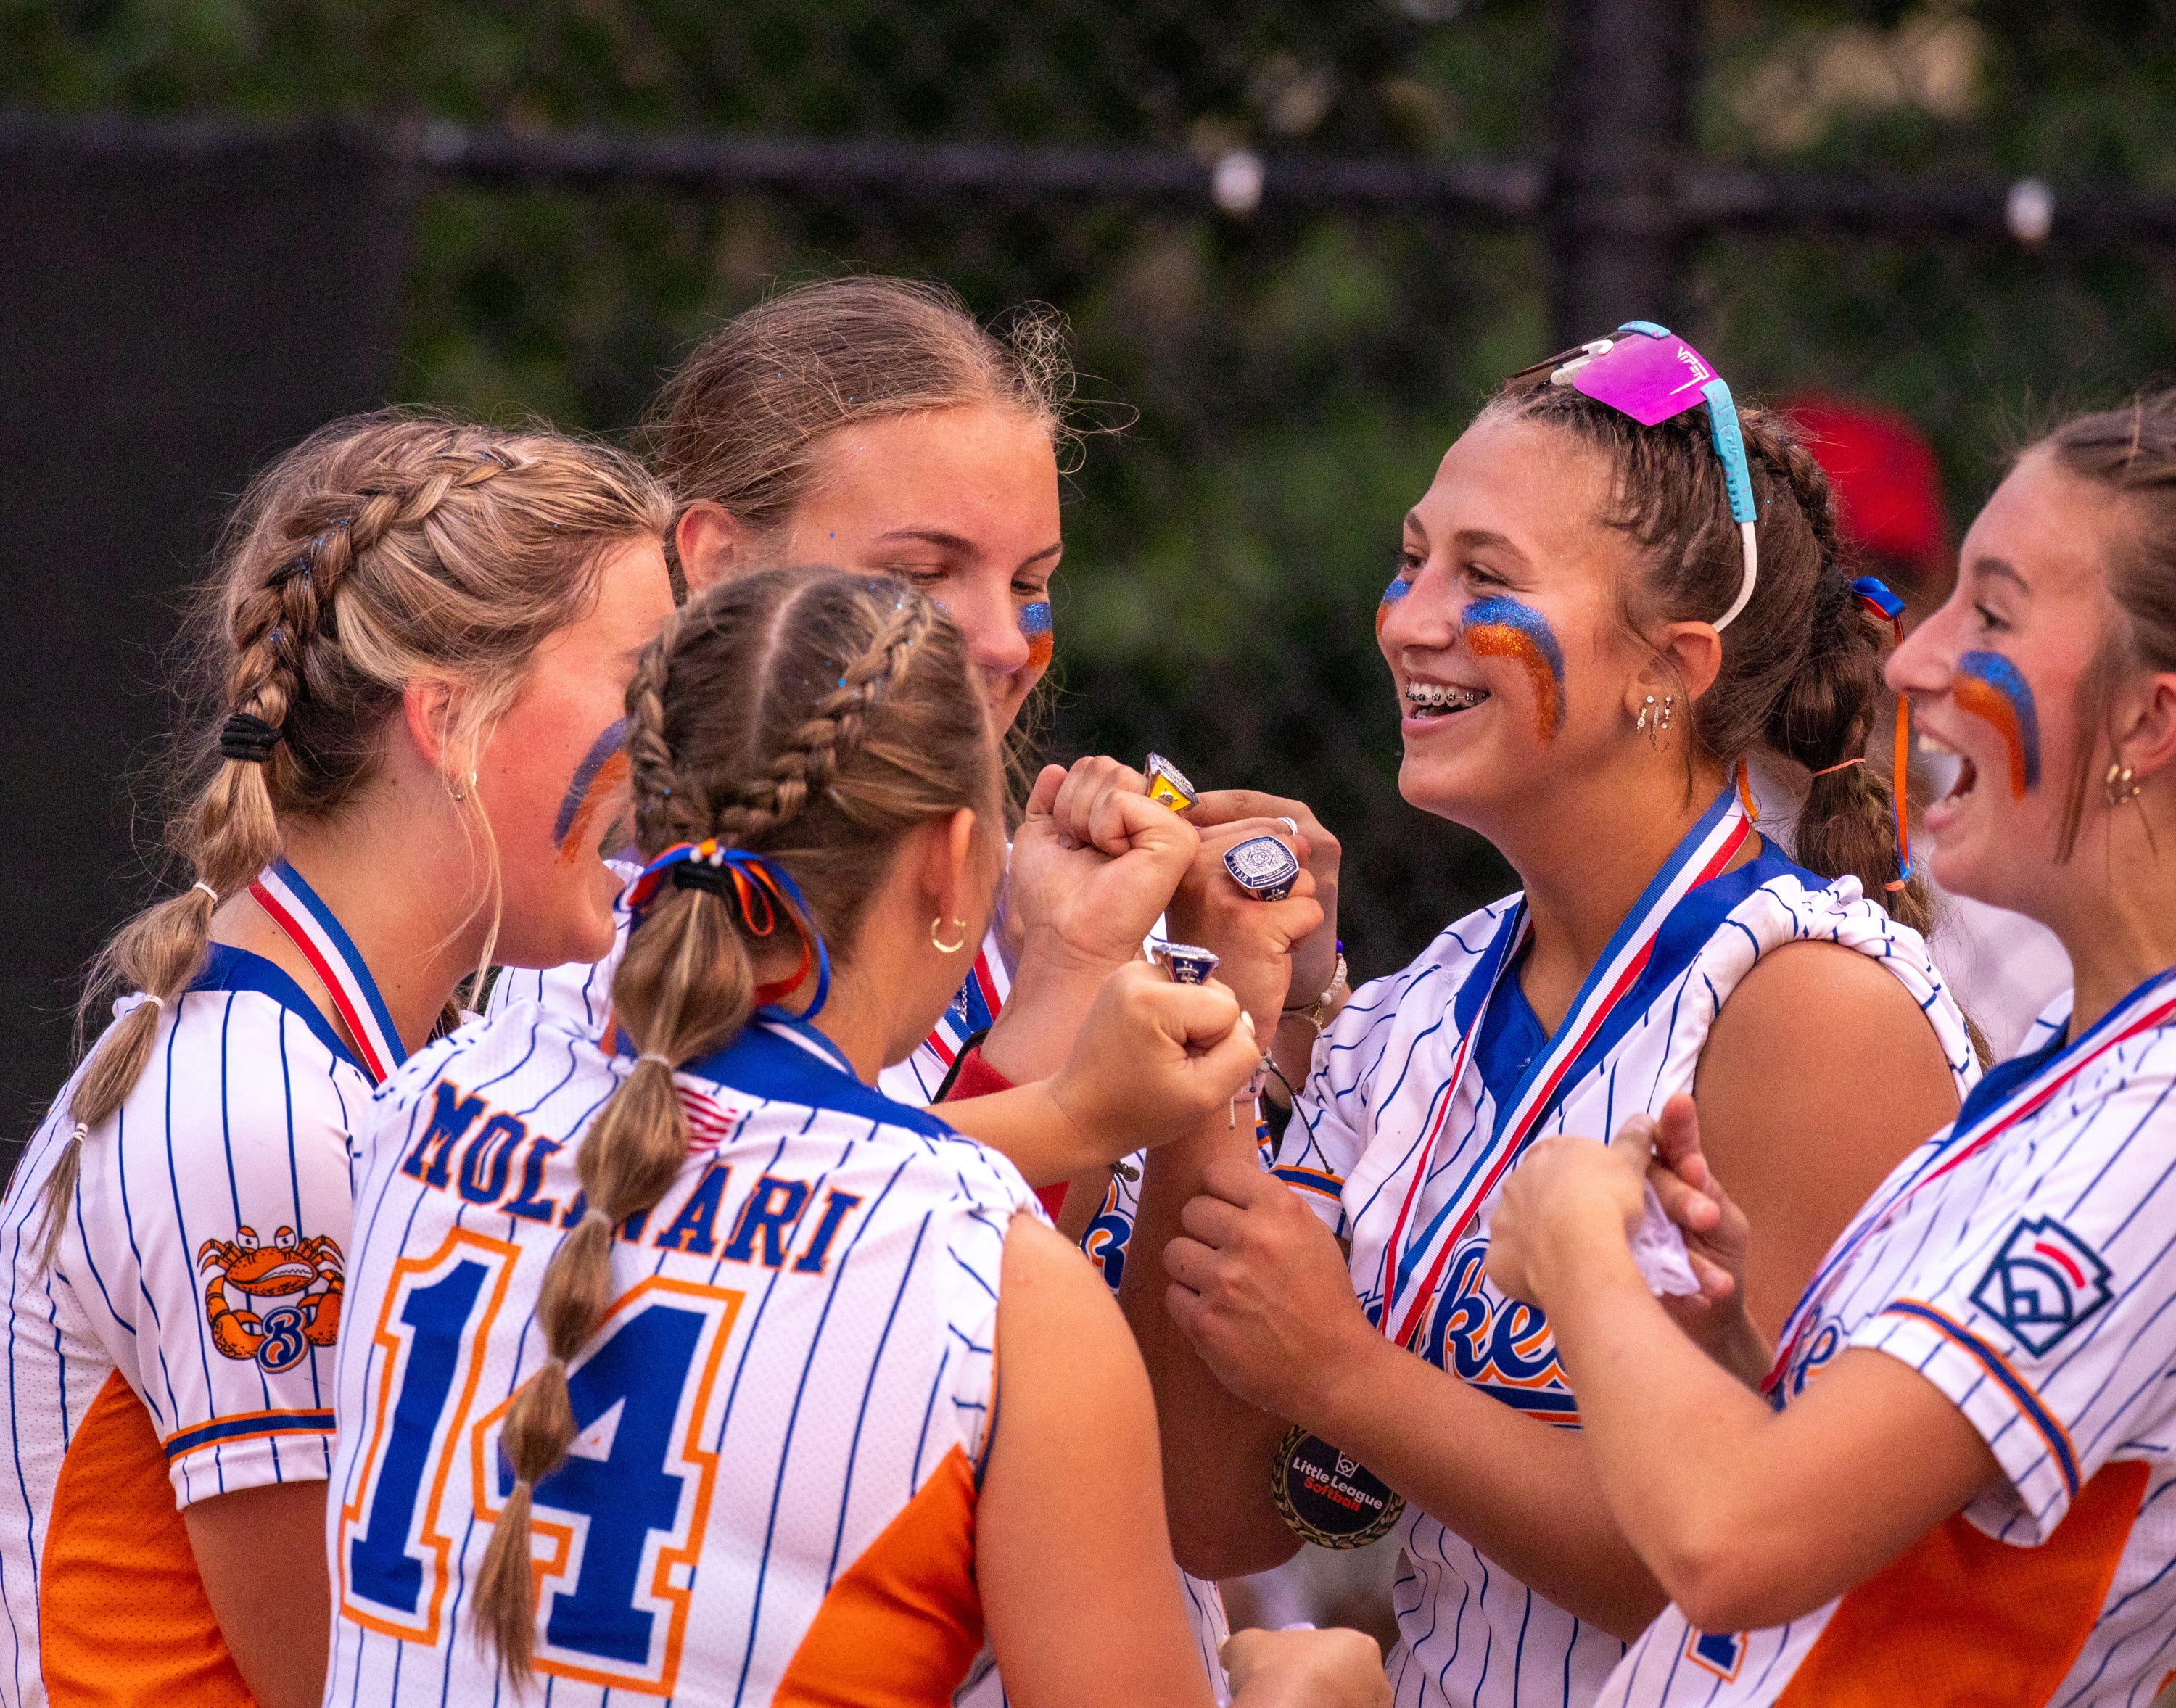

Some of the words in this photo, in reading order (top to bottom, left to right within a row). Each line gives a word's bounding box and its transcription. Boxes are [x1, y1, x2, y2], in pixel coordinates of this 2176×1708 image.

[400, 1078, 864, 1276] MOLARI
[257, 1305, 308, 1374] B
[339, 1227, 746, 1697] 14
[1293, 1456, 1330, 1483] Little
[1330, 1475, 1383, 1509] League
[1304, 1477, 1361, 1512] Softball
